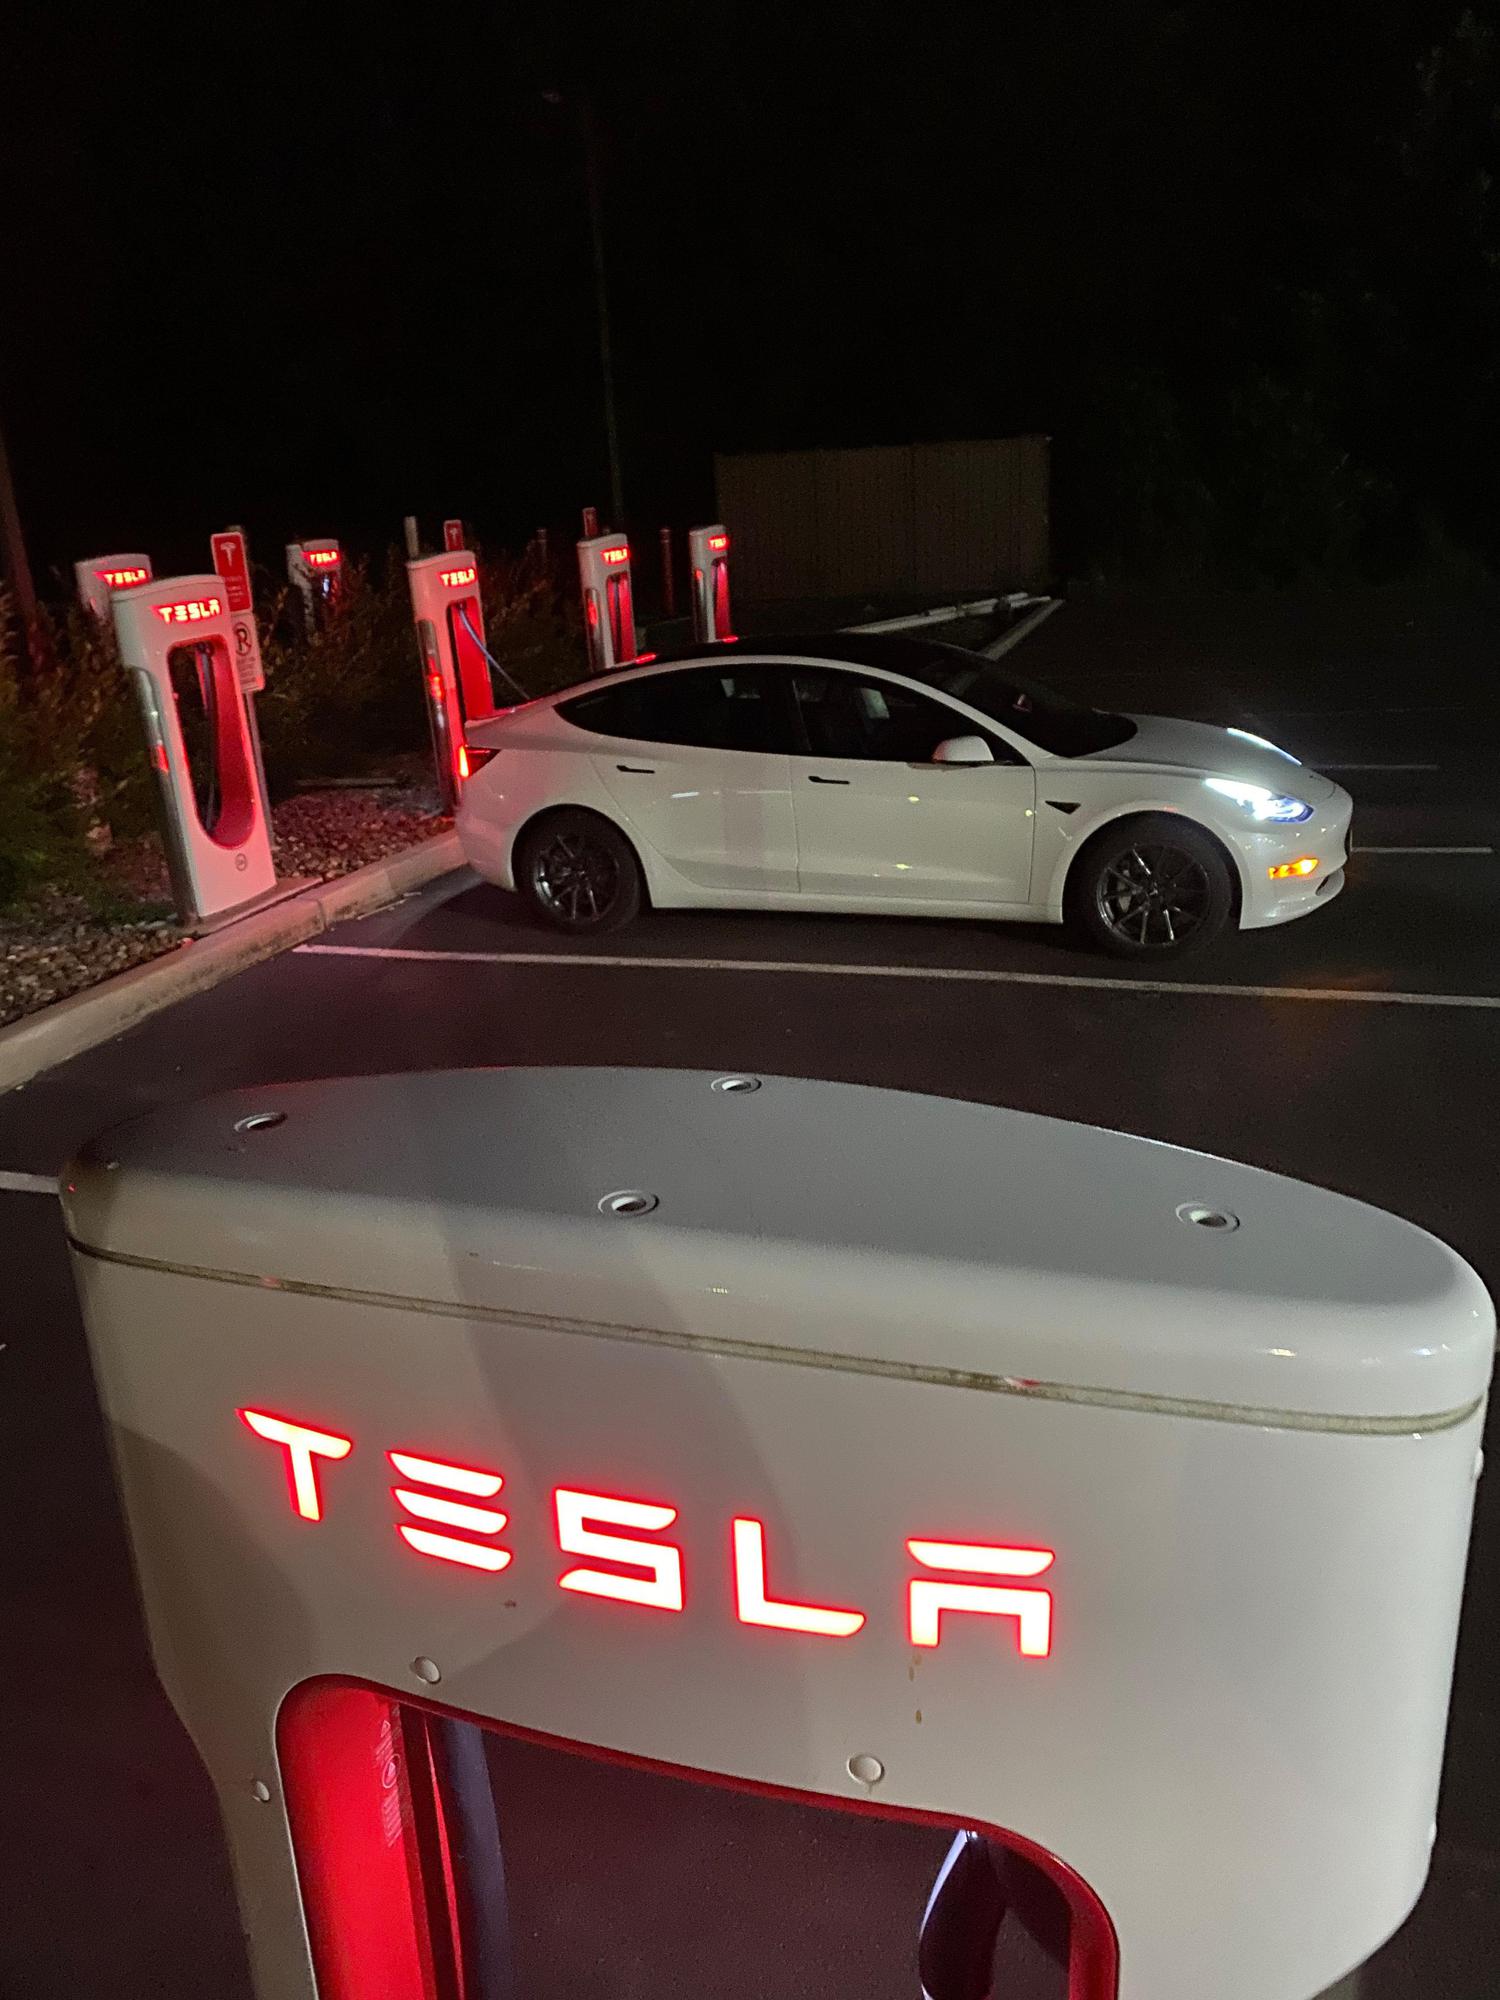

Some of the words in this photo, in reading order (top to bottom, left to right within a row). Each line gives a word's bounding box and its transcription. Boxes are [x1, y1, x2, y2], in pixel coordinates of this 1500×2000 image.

[104, 568, 147, 586] TESLA
[440, 568, 475, 587] TESLA
[157, 598, 222, 624] TESLA
[235, 1406, 1057, 1659] TESLA
